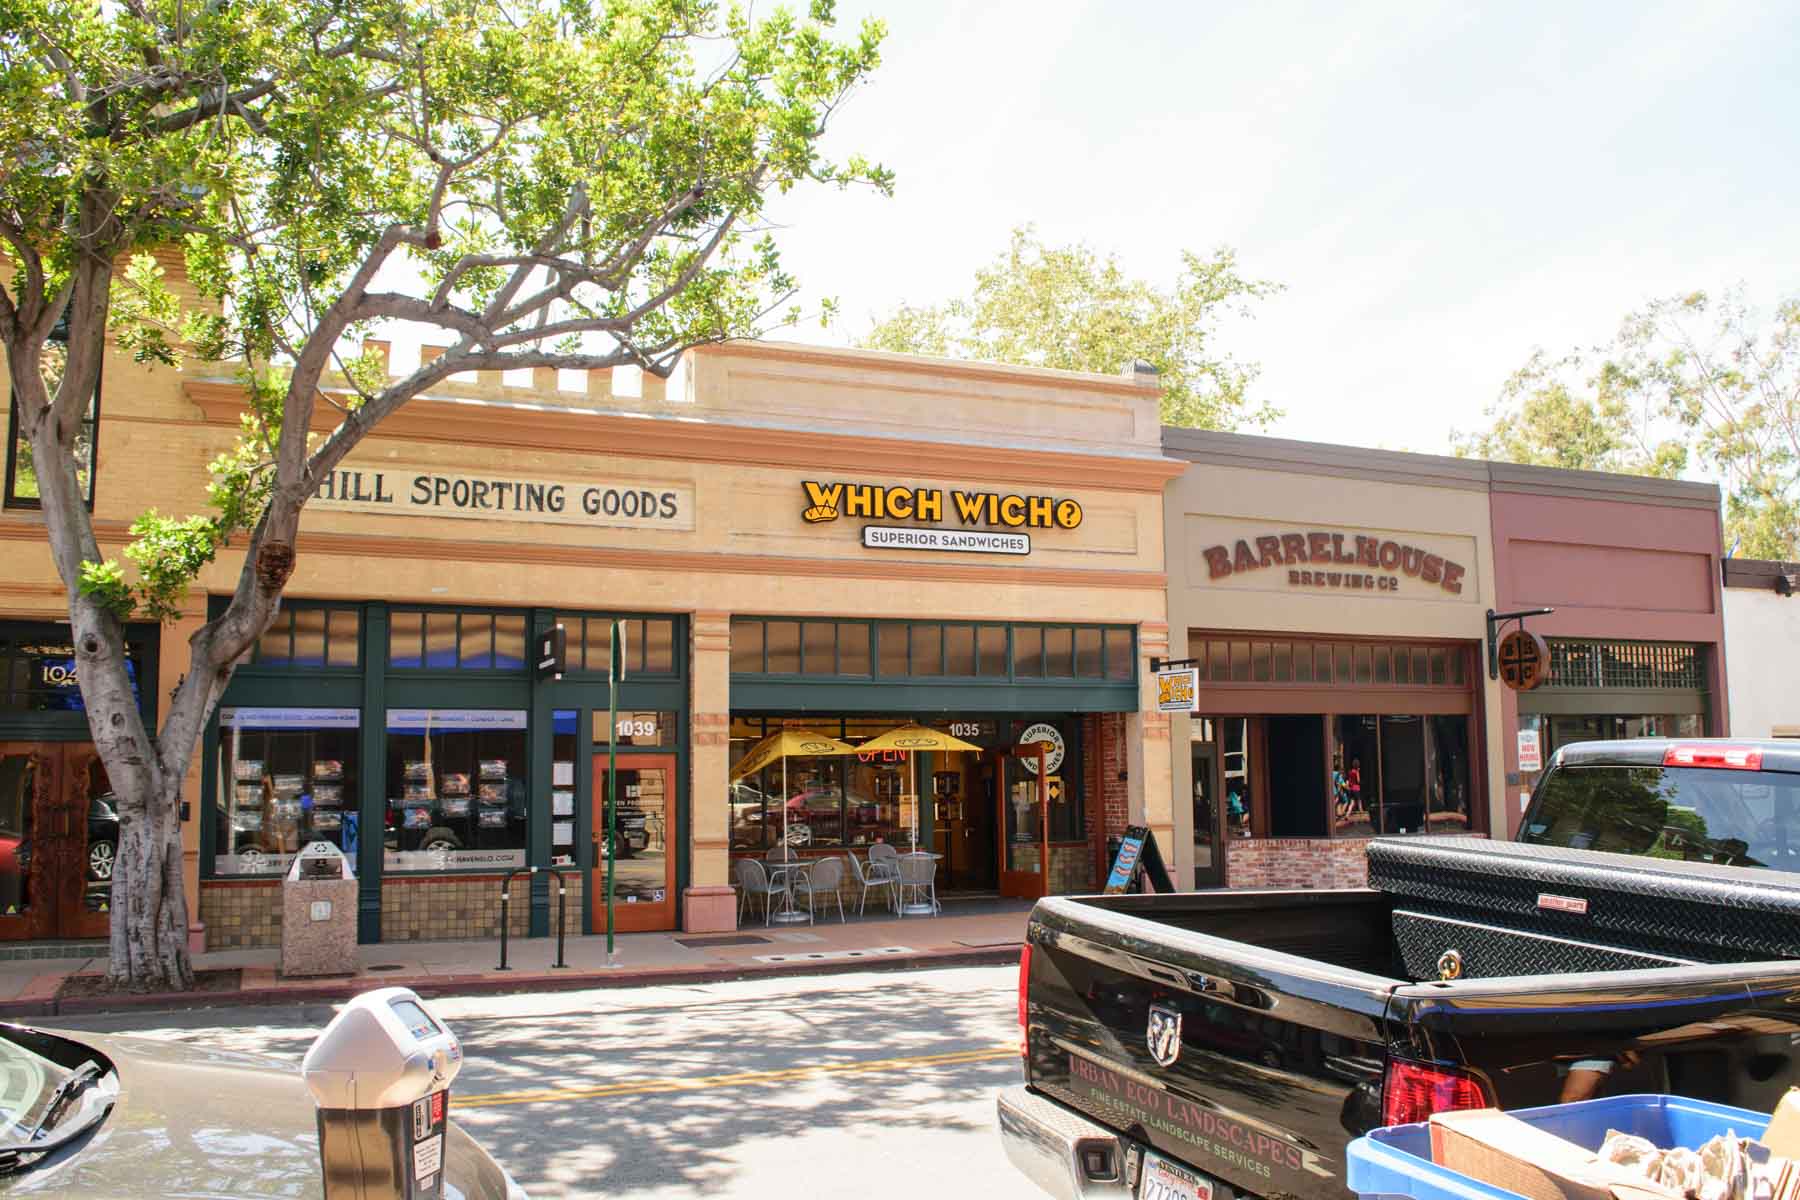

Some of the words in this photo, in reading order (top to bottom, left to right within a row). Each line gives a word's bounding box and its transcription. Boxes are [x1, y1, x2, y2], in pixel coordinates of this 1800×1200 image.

[411, 475, 566, 513] SPORTING
[582, 487, 678, 519] GOODS
[801, 481, 943, 523] WHICH
[871, 531, 937, 546] SUPERIOR
[941, 536, 1024, 551] SANDWICHES
[1202, 532, 1466, 594] BARRELHOUSE
[1288, 570, 1374, 590] BREWING
[616, 720, 655, 737] 1039
[949, 723, 980, 737] 1035
[1023, 726, 1060, 743] SUPERIOR
[1069, 1054, 1121, 1093] URBAN
[1126, 1079, 1160, 1111] ECO
[1166, 1095, 1301, 1171] LANDSCAPES
[1090, 1087, 1111, 1105] FINE
[1113, 1098, 1150, 1122] ESTATE
[1149, 1114, 1211, 1152] LANDSCAPE
[1213, 1144, 1272, 1178] SERVICES
